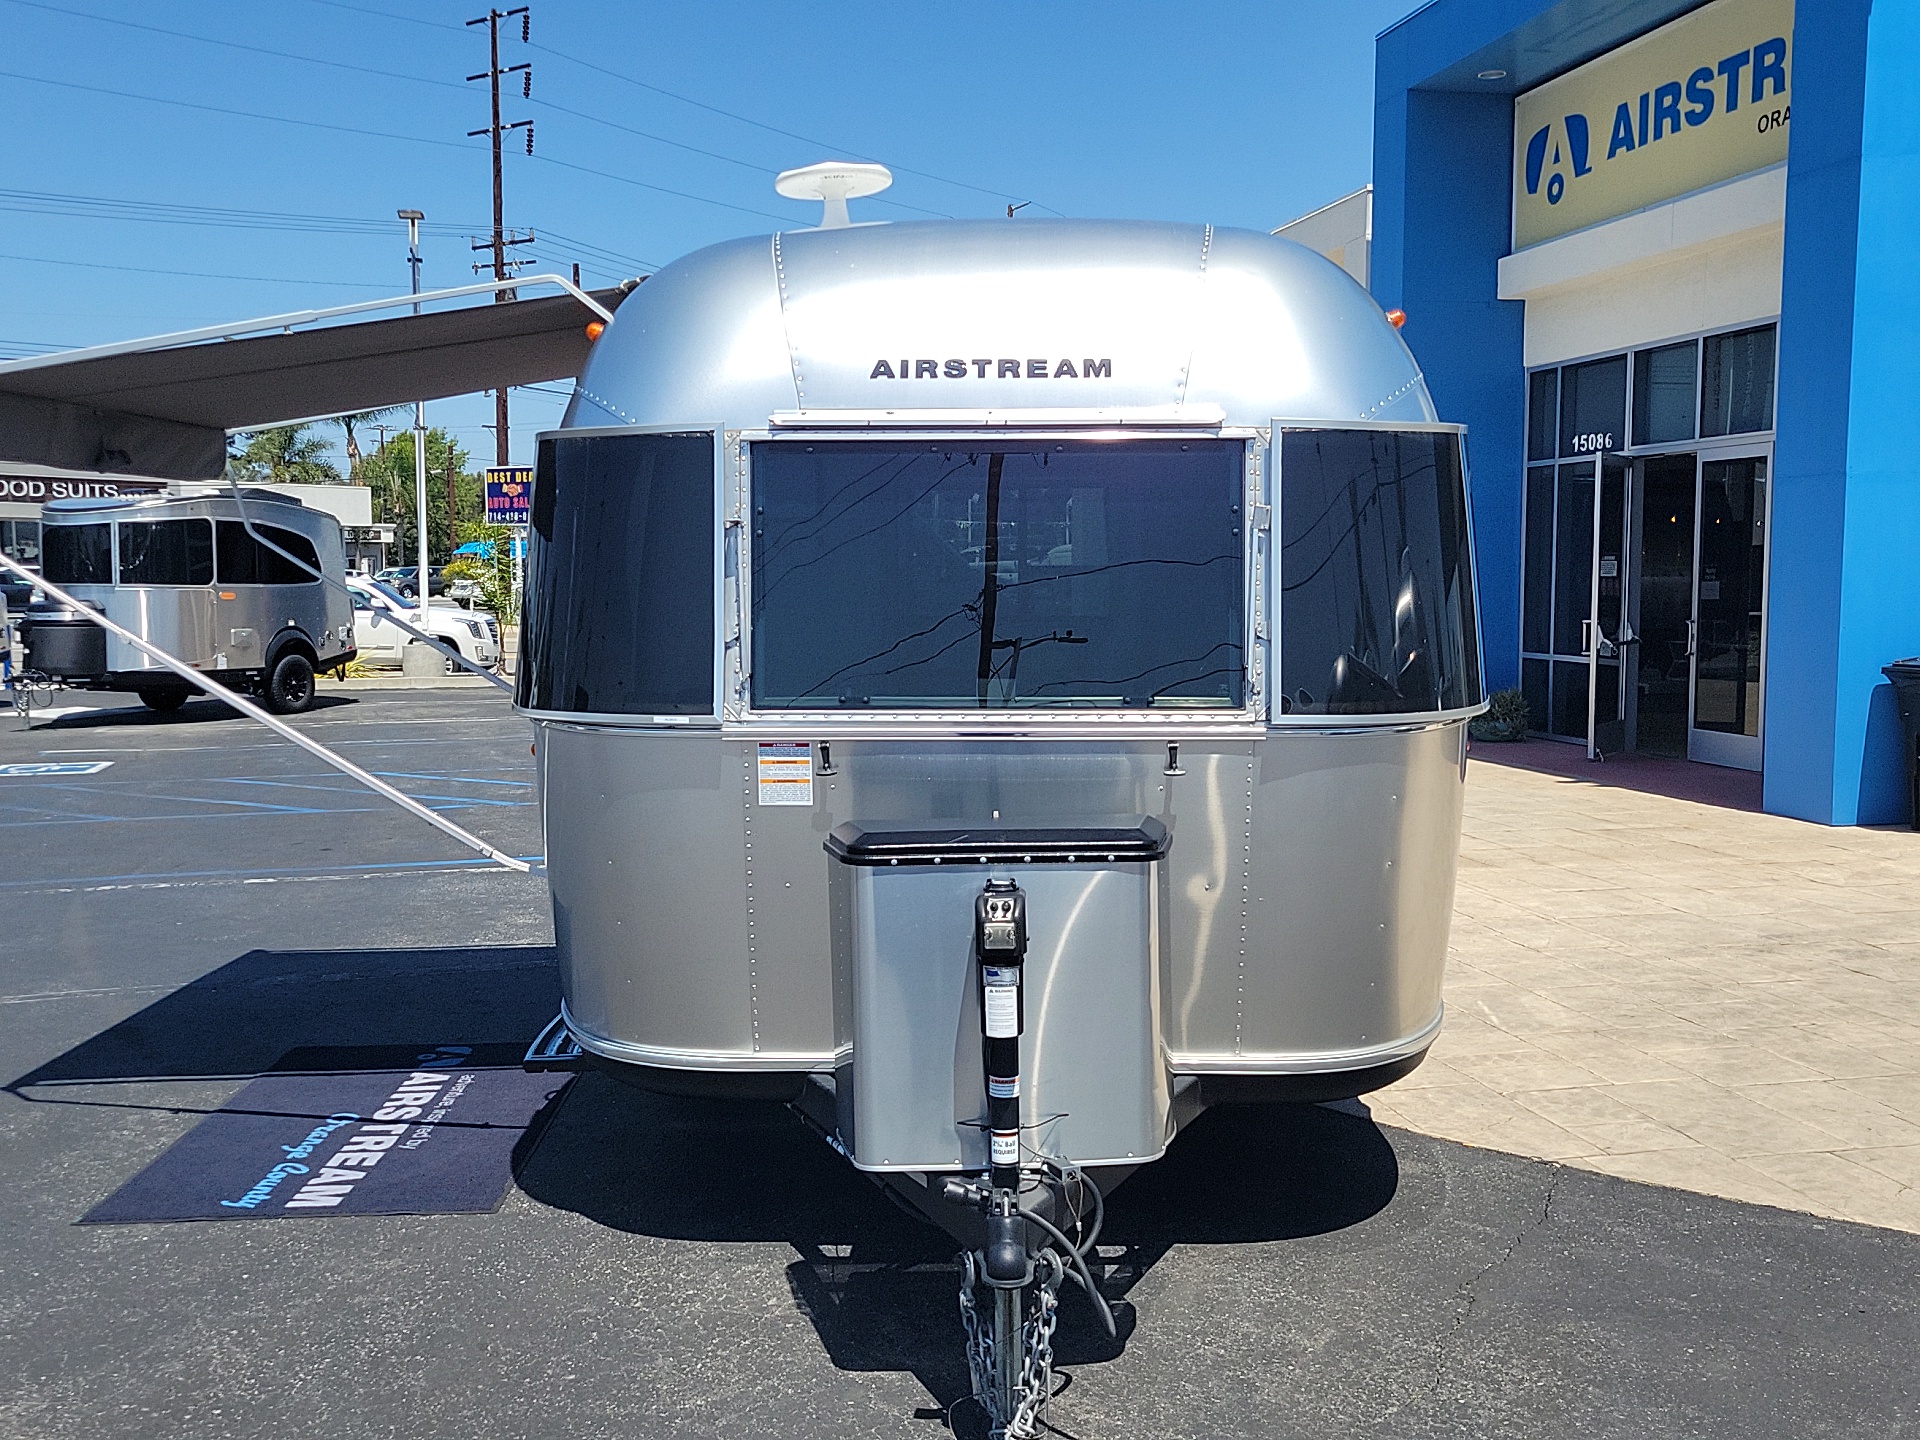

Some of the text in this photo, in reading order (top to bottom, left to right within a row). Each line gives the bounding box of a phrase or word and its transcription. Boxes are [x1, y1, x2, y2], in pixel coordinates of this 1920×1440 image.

[1606, 37, 1787, 160] AIRSTR
[869, 358, 1113, 380] AIRSTREAM
[1572, 432, 1613, 453] 15086
[487, 471, 511, 483] BEST
[52, 482, 119, 499] SUITS
[488, 497, 510, 509] AUTO
[285, 1072, 452, 1209] AIRSTREAM
[220, 1112, 360, 1209] Orange County
